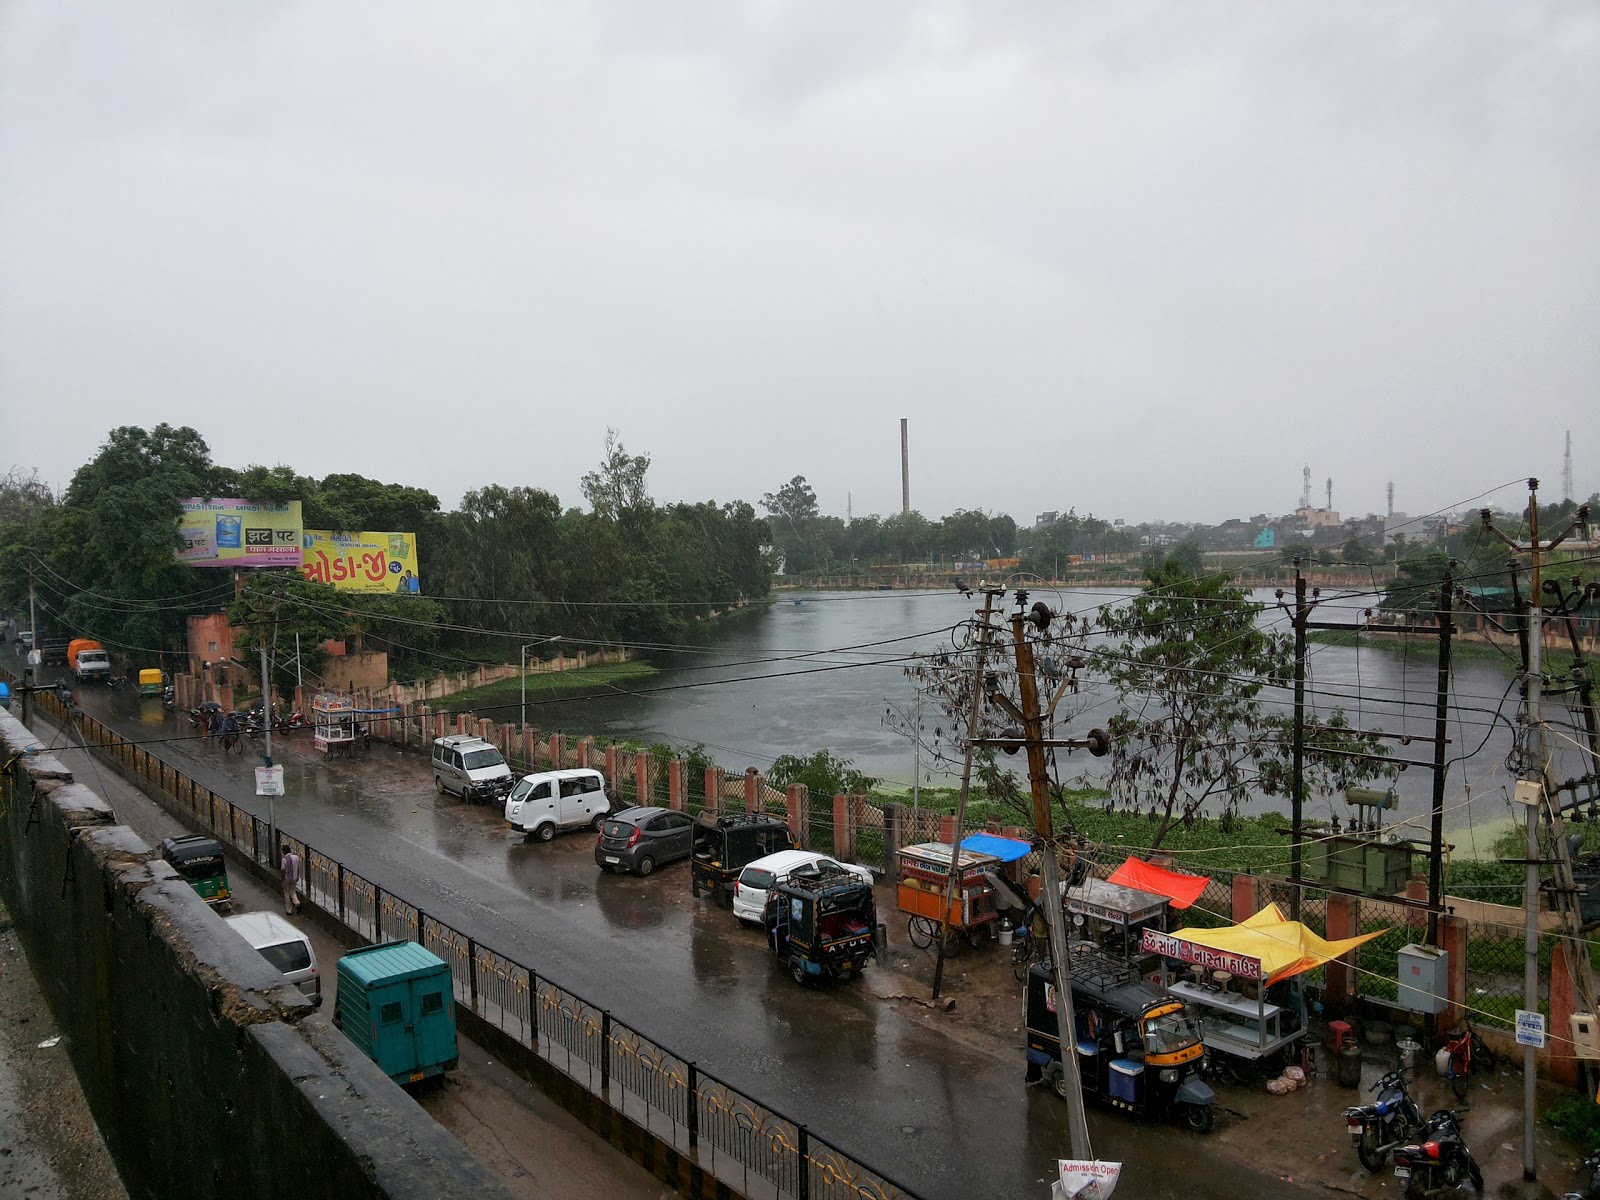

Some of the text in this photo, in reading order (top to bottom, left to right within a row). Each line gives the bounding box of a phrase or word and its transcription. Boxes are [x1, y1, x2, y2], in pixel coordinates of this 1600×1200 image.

[247, 530, 270, 544] झट
[275, 530, 295, 542] पट
[829, 938, 867, 953] ATUL
[1193, 950, 1226, 971] નાસ્તા
[1229, 956, 1260, 978] હાઉસ
[1063, 1163, 1119, 1175] Admission Open
